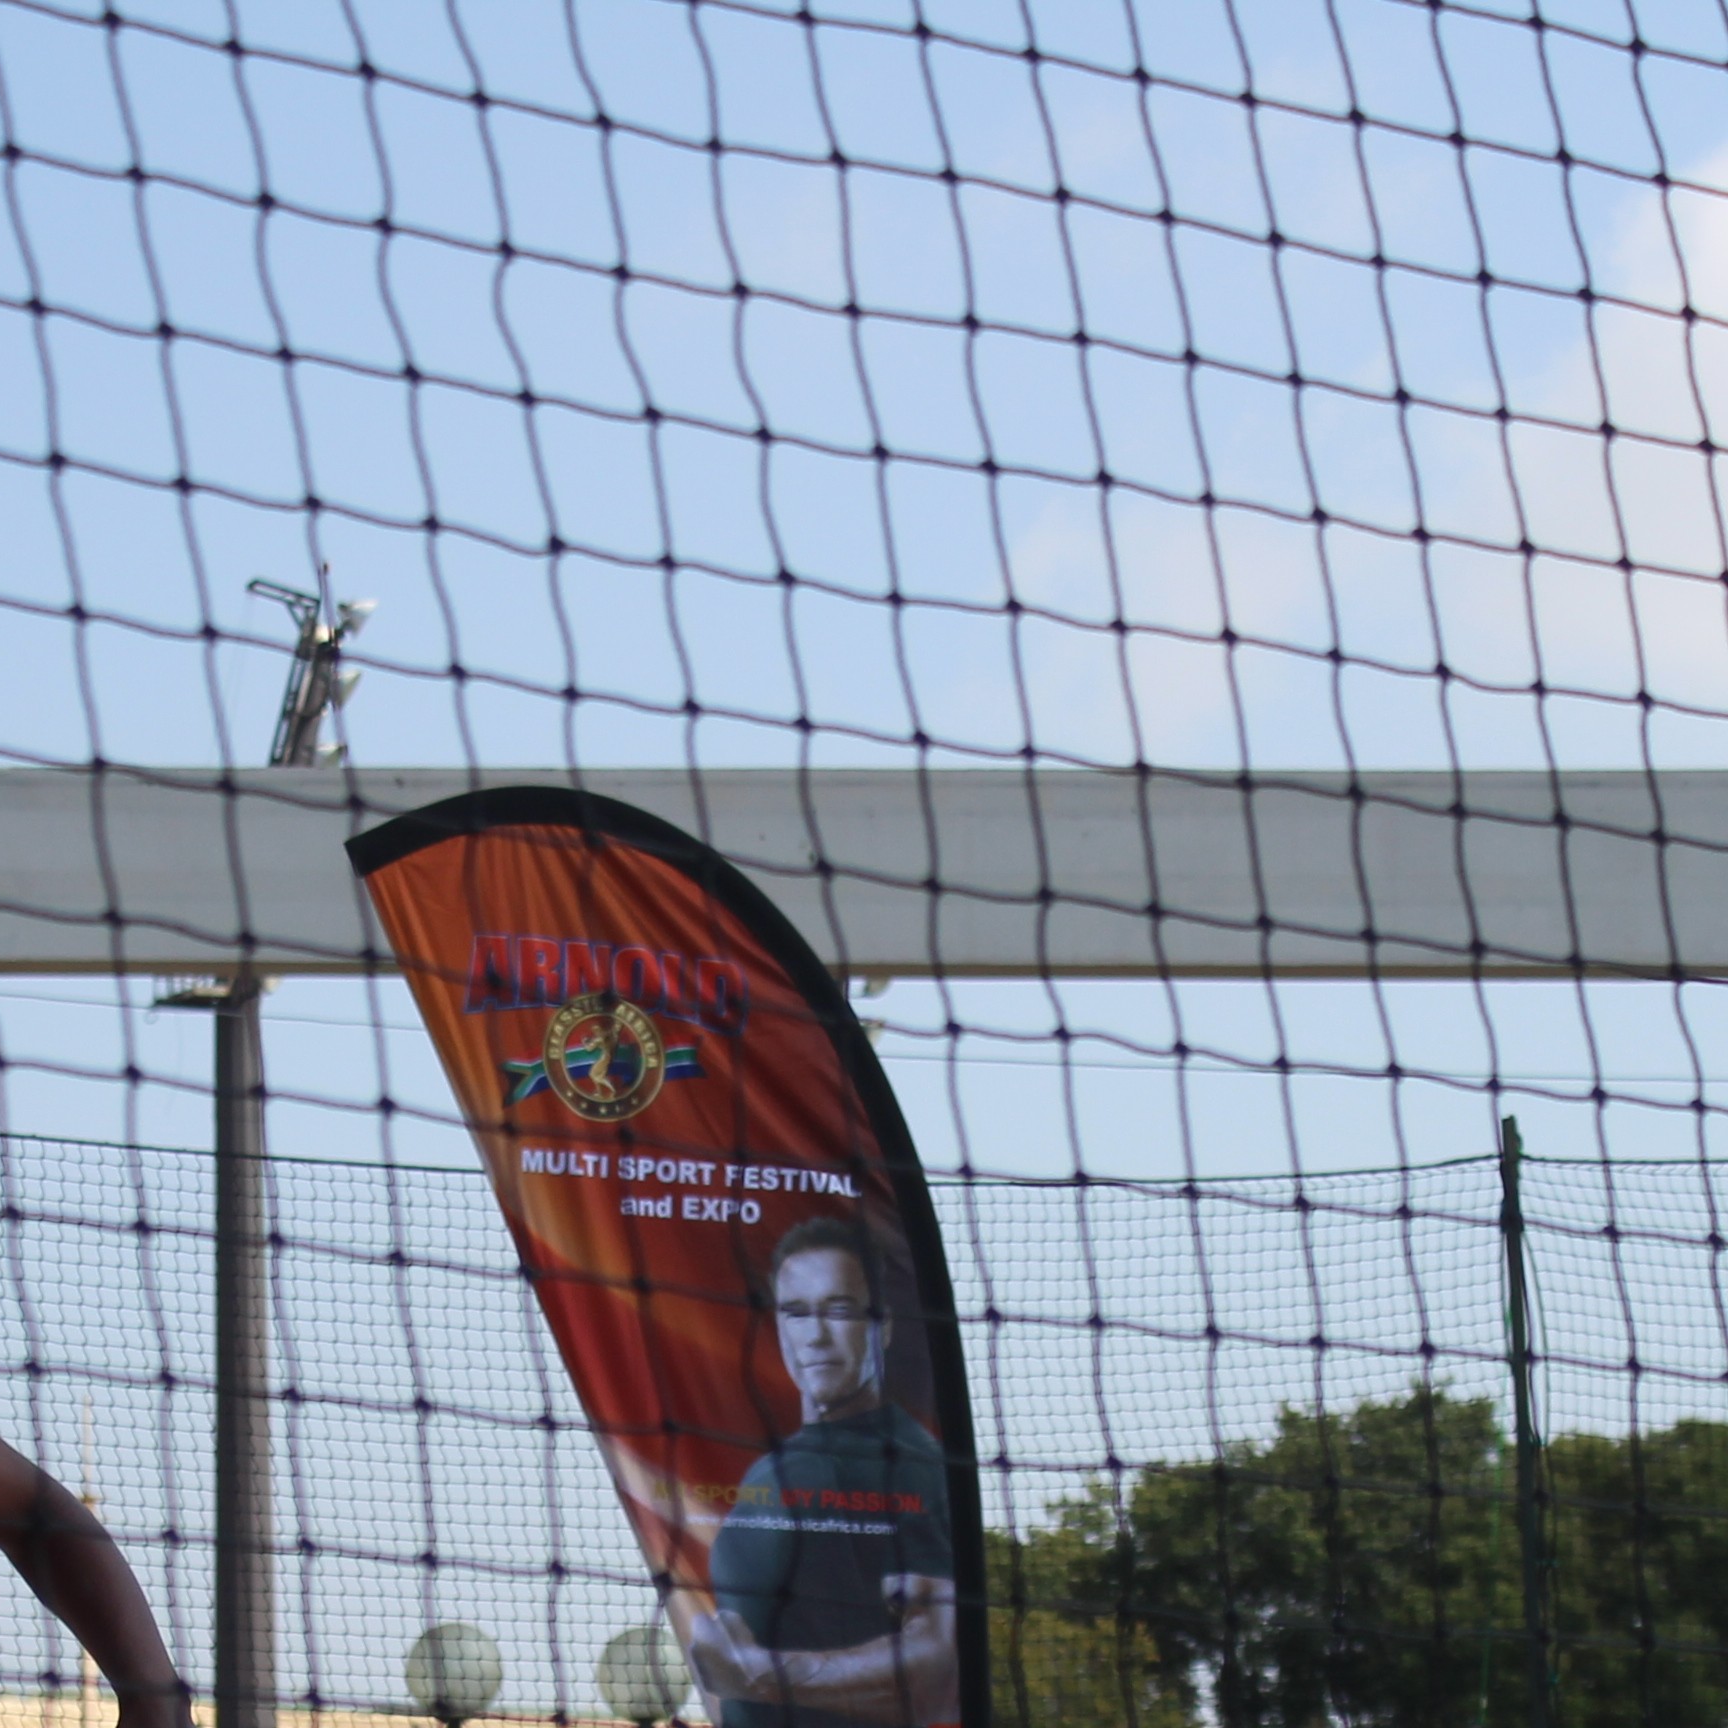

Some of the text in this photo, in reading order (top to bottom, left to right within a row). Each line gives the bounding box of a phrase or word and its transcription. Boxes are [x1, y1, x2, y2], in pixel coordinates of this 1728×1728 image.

[464, 933, 750, 1037] ARNOLD
[522, 1149, 862, 1198] MULTI SPORT FESTIVAL
[622, 1198, 762, 1224] and EXPO
[780, 1487, 815, 1508] MY
